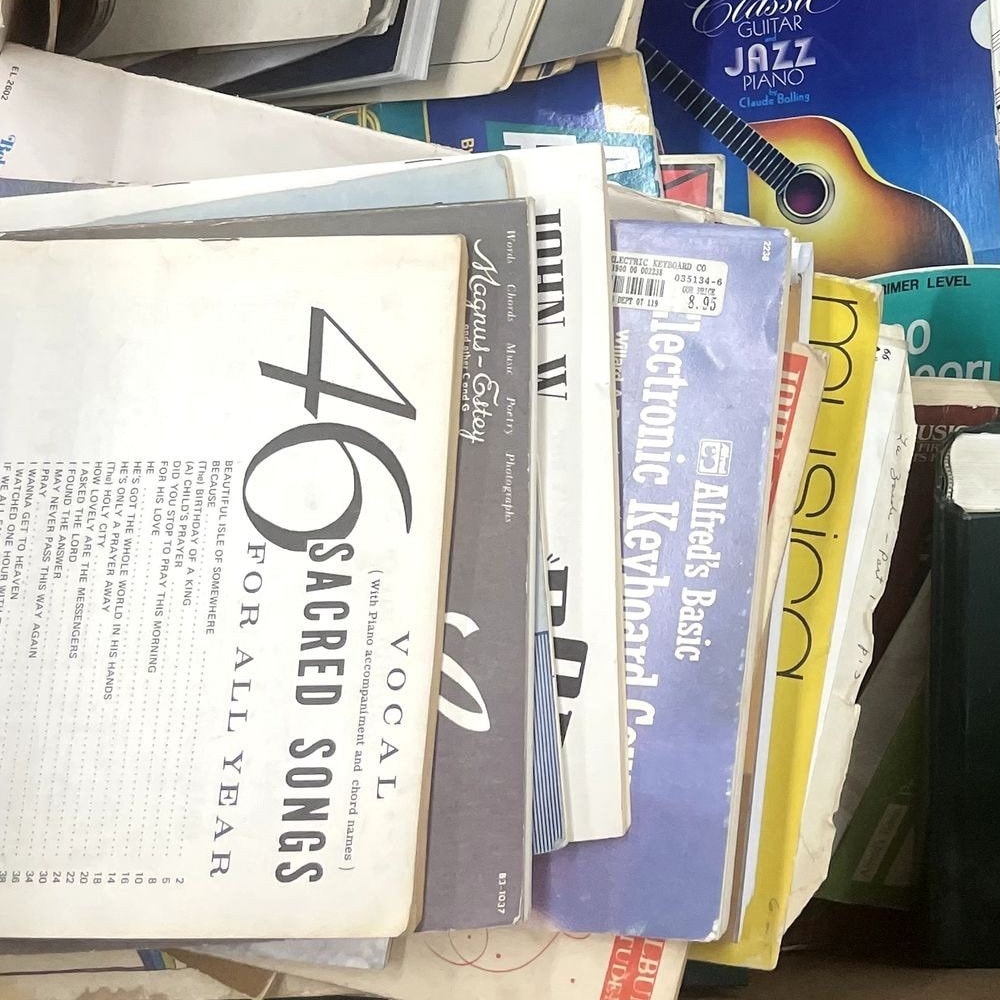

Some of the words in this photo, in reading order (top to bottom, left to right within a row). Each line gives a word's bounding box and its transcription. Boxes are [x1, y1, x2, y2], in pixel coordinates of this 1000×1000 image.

[737, 14, 804, 40] GUITAR
[9, 65, 19, 78] EL
[723, 36, 818, 78] JAZZ
[738, 94, 775, 110] Claude
[776, 91, 811, 107] Bolling
[741, 67, 806, 92] PIANO
[505, 229, 518, 265] Words
[652, 259, 693, 271] KEYBOARD
[696, 263, 707, 272] CO
[761, 240, 772, 262] 2238
[674, 273, 723, 287] 035134-6
[926, 274, 972, 290] LEVEL
[505, 284, 518, 323] Chords
[687, 294, 718, 312] 8.95
[505, 342, 517, 376] Music
[242, 305, 418, 553] 46
[502, 396, 517, 436] Poetry
[179, 478, 193, 521] CHILD'S
[206, 459, 221, 509] BECAUSE
[217, 459, 233, 521] BEAUTIFUL
[501, 453, 517, 524] Photographs
[173, 523, 189, 568] PRAYER
[215, 523, 227, 546] ISLE
[683, 479, 729, 579] Alfred's
[205, 566, 222, 636] SOMEWHERE
[239, 541, 267, 630] FOR
[368, 578, 382, 607] With
[622, 500, 682, 688] Keyboard
[295, 542, 355, 706] SACRED
[365, 611, 379, 647] Piano
[674, 587, 712, 662] Basic
[146, 620, 164, 674] MORNING
[103, 661, 117, 701] HANDS
[226, 646, 254, 733] ALL
[354, 649, 374, 747] accompaniment
[376, 630, 411, 801] VOCAL
[352, 749, 365, 773] and
[208, 750, 244, 879] YEAR
[275, 737, 337, 885] SONGS
[348, 779, 363, 816] chord
[343, 819, 356, 861] names
